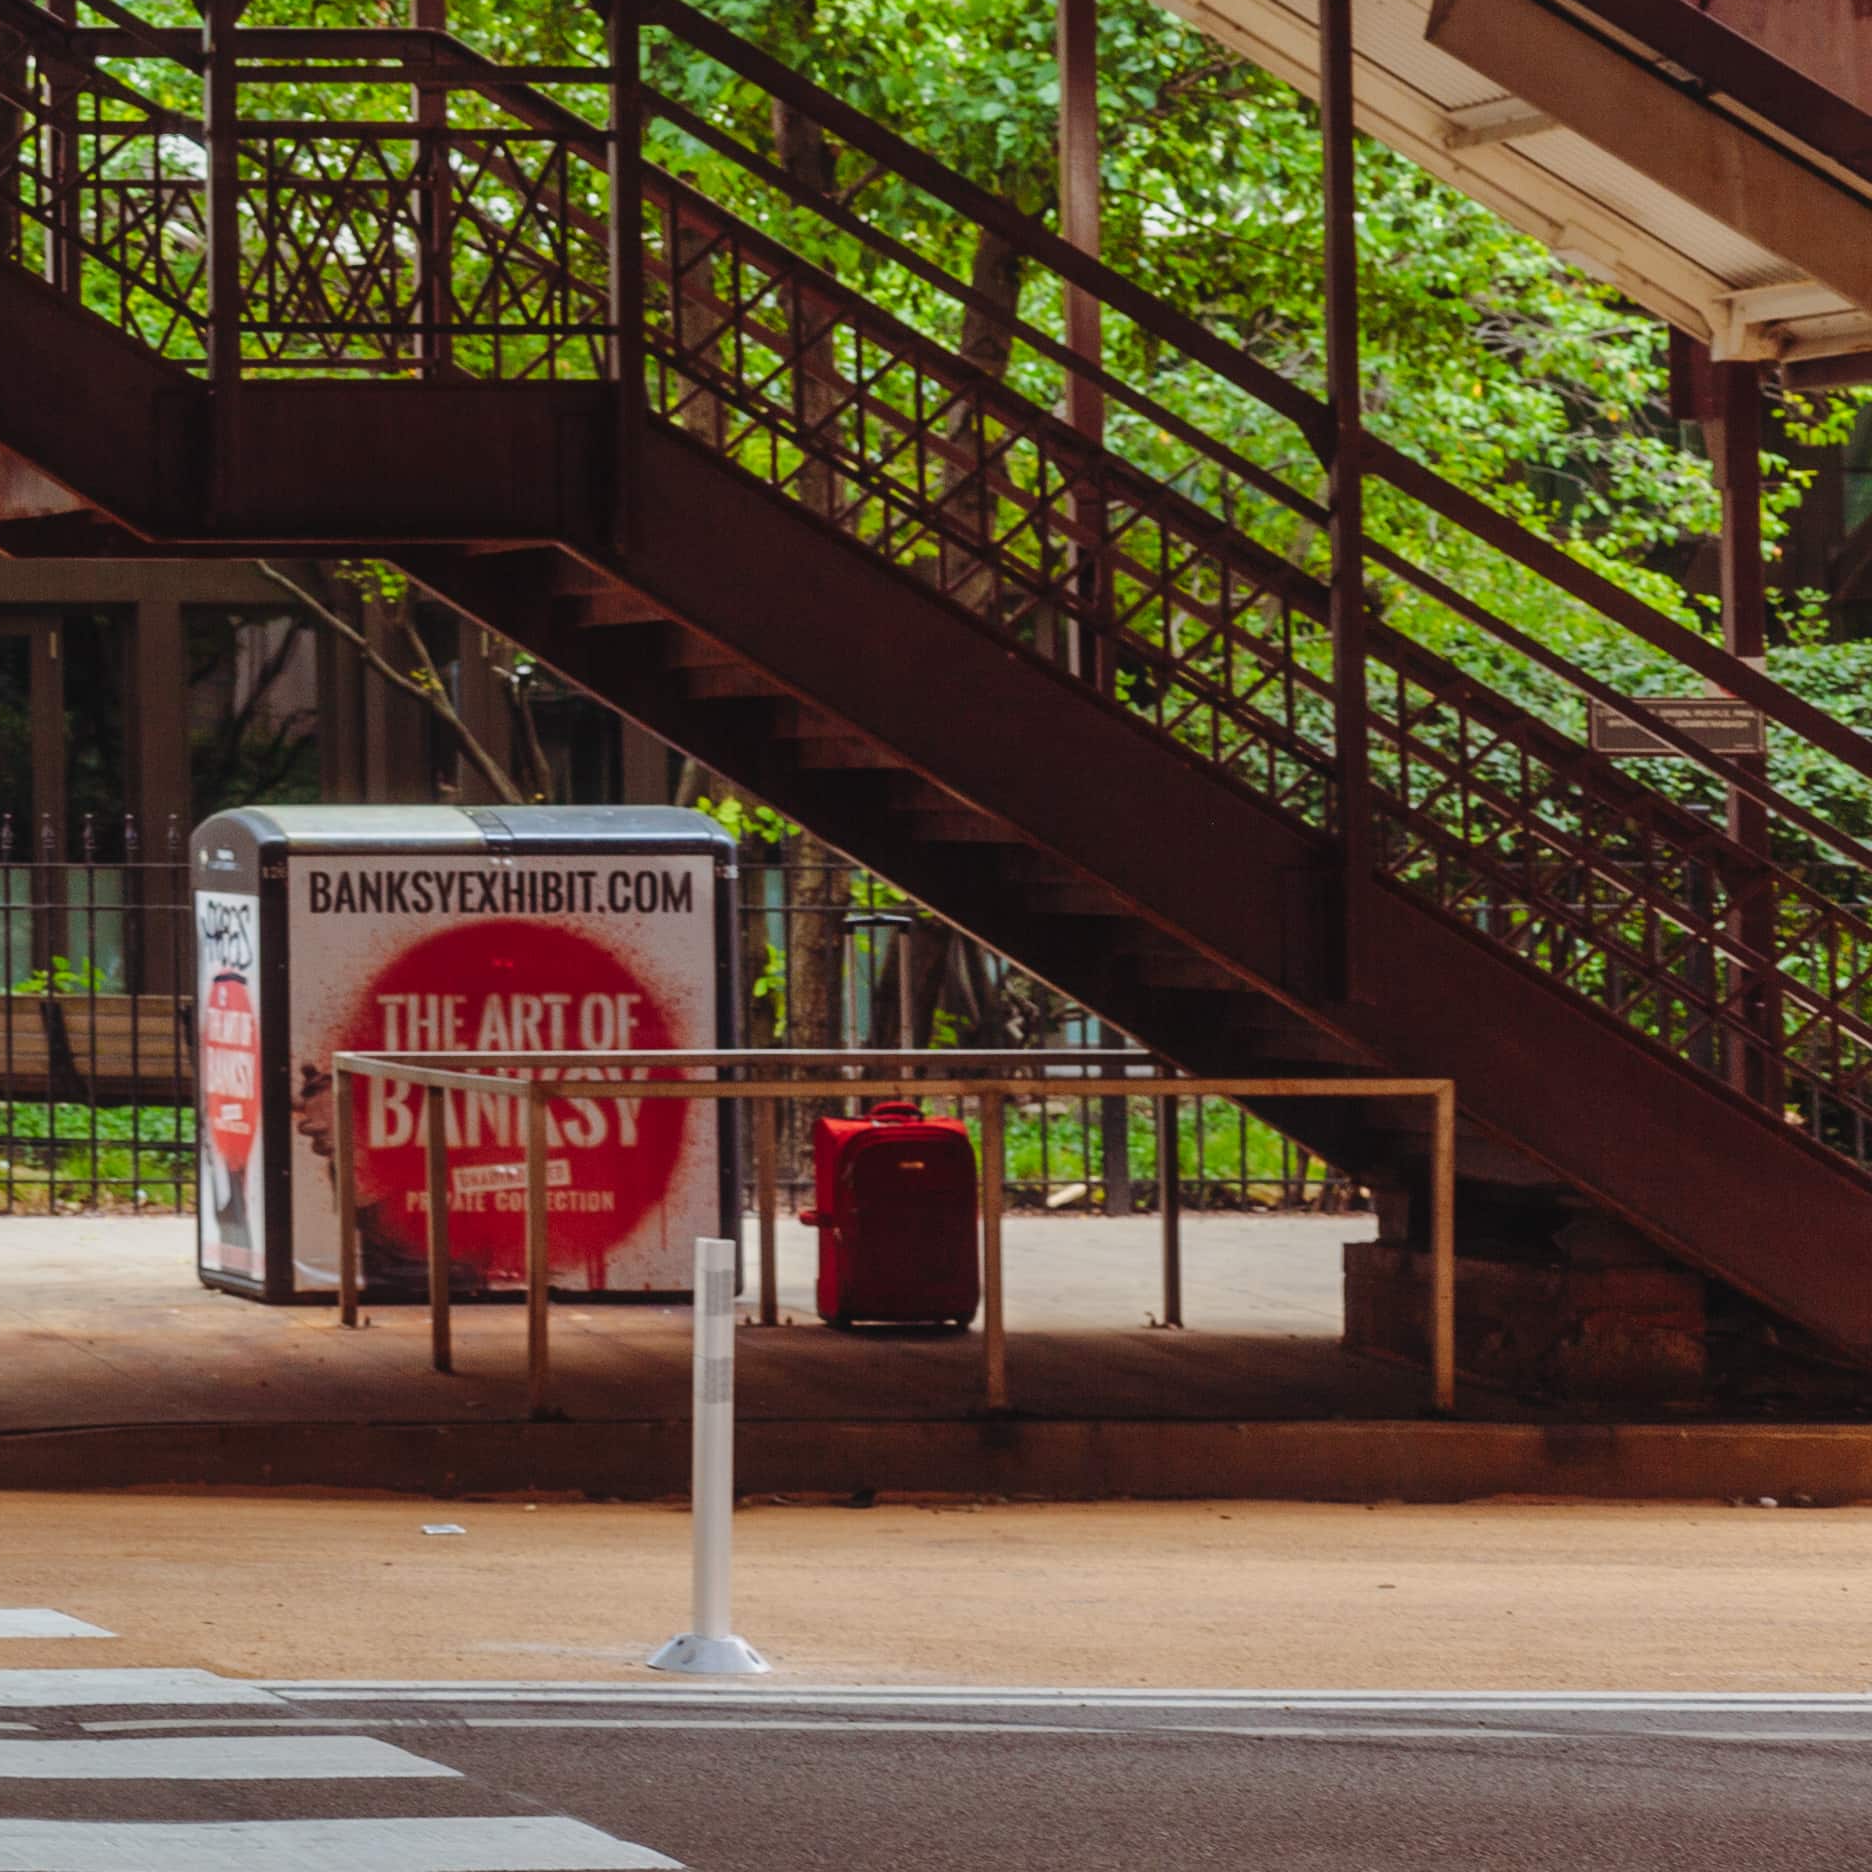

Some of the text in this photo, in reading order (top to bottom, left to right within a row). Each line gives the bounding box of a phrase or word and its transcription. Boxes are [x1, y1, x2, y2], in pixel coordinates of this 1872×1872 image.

[309, 870, 694, 915] BANKSYEXHIBIT.COM
[376, 992, 642, 1051] THE ART OF
